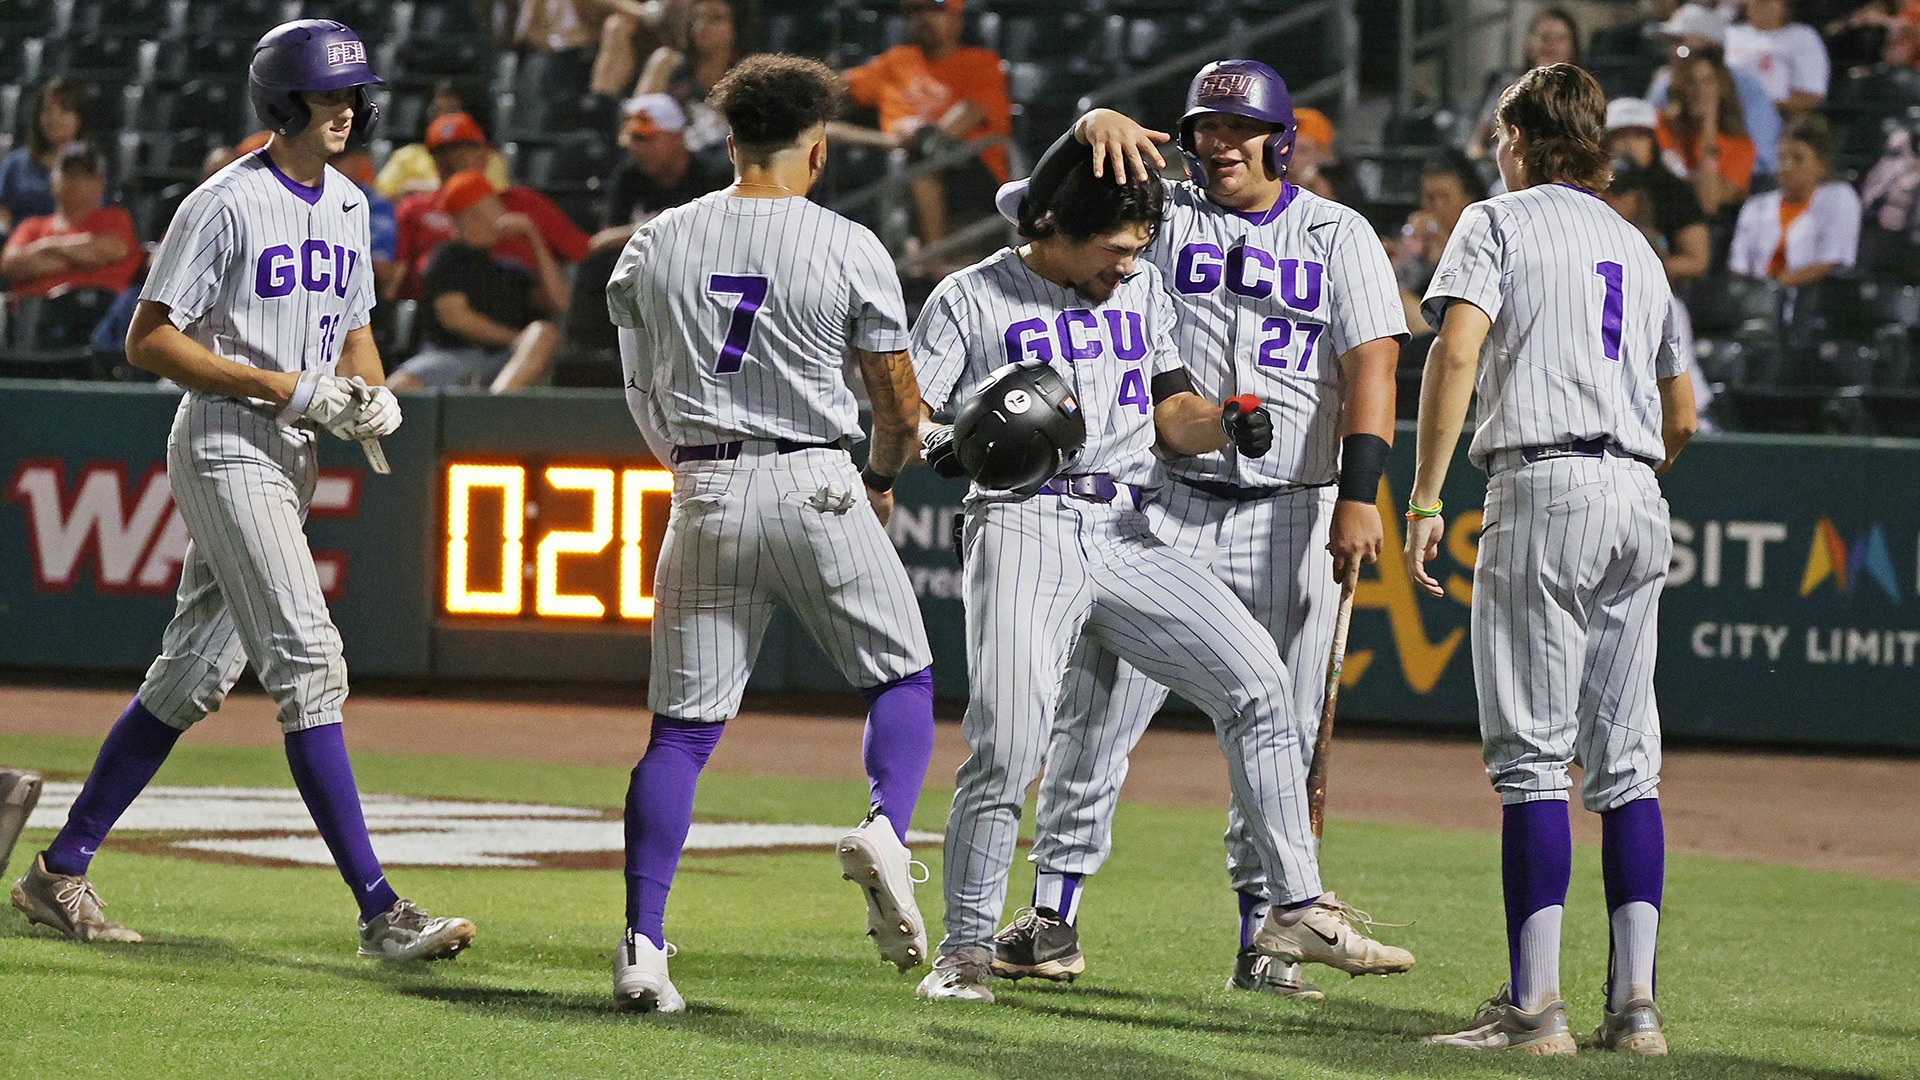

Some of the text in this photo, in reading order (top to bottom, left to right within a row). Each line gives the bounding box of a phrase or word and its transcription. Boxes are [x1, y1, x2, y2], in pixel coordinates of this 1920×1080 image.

[253, 237, 359, 300] GCU
[1174, 242, 1324, 313] GCU
[707, 271, 771, 376] 7
[1003, 306, 1148, 366] GCU
[1594, 259, 1624, 363] 1
[1257, 315, 1325, 373] 27
[1117, 366, 1151, 416] 4
[1692, 620, 1920, 668] CITY LIMIT
